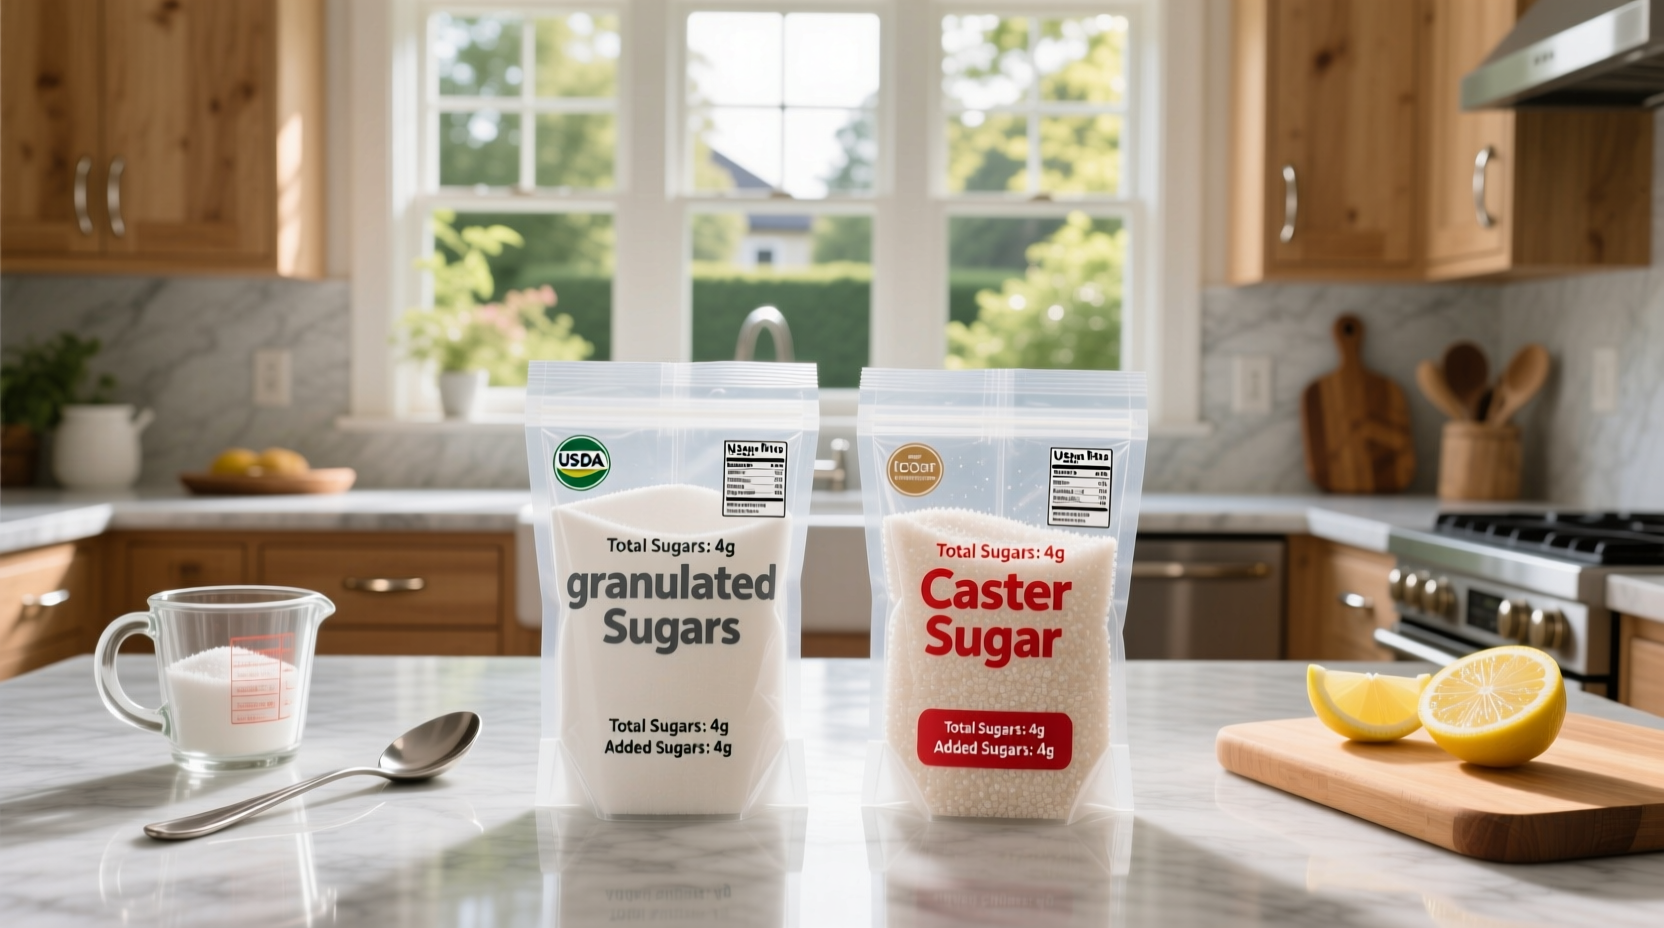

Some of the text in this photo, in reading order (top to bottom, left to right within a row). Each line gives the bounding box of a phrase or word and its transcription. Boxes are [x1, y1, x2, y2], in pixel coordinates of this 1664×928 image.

[558, 453, 605, 468] USDA
[607, 538, 736, 557] Total Sugars: 4g
[936, 543, 1065, 564] Total Sugars: 4g
[567, 564, 776, 610] granulated
[921, 568, 1072, 612] Caster
[603, 608, 741, 655] Sugars
[925, 614, 1062, 668] Sugar
[609, 718, 729, 737] Total Sugars: 4g
[944, 721, 1045, 739] Total Sugars: 4g
[604, 739, 732, 758] Added Sugars: 4g
[933, 739, 1055, 760] Added Sugars: 4g
